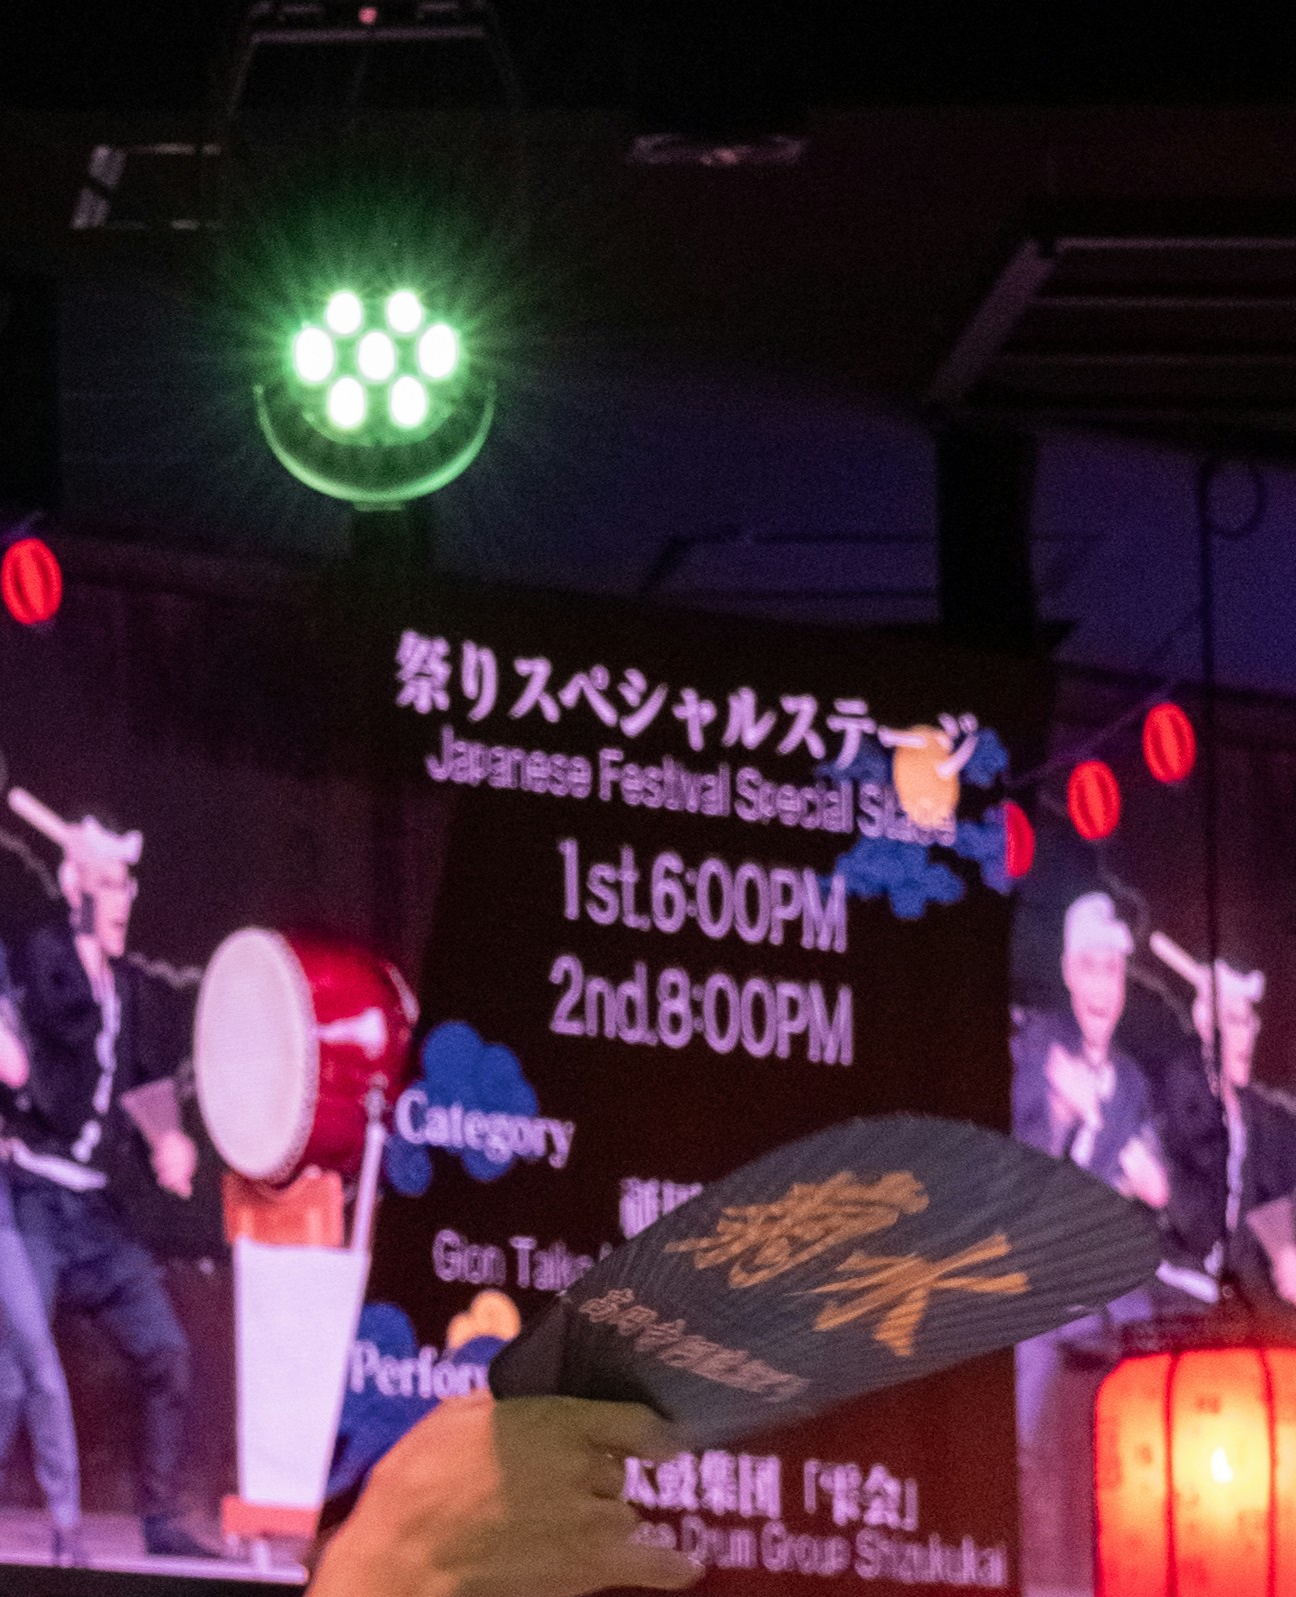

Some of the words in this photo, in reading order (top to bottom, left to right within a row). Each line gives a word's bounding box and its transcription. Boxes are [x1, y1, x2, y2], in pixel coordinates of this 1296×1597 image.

[395, 629, 979, 770] 祭りスペシャルステージ
[426, 724, 593, 799] Japanese
[599, 748, 731, 817] Festival
[735, 765, 854, 834] Special
[395, 1089, 576, 1169] Category
